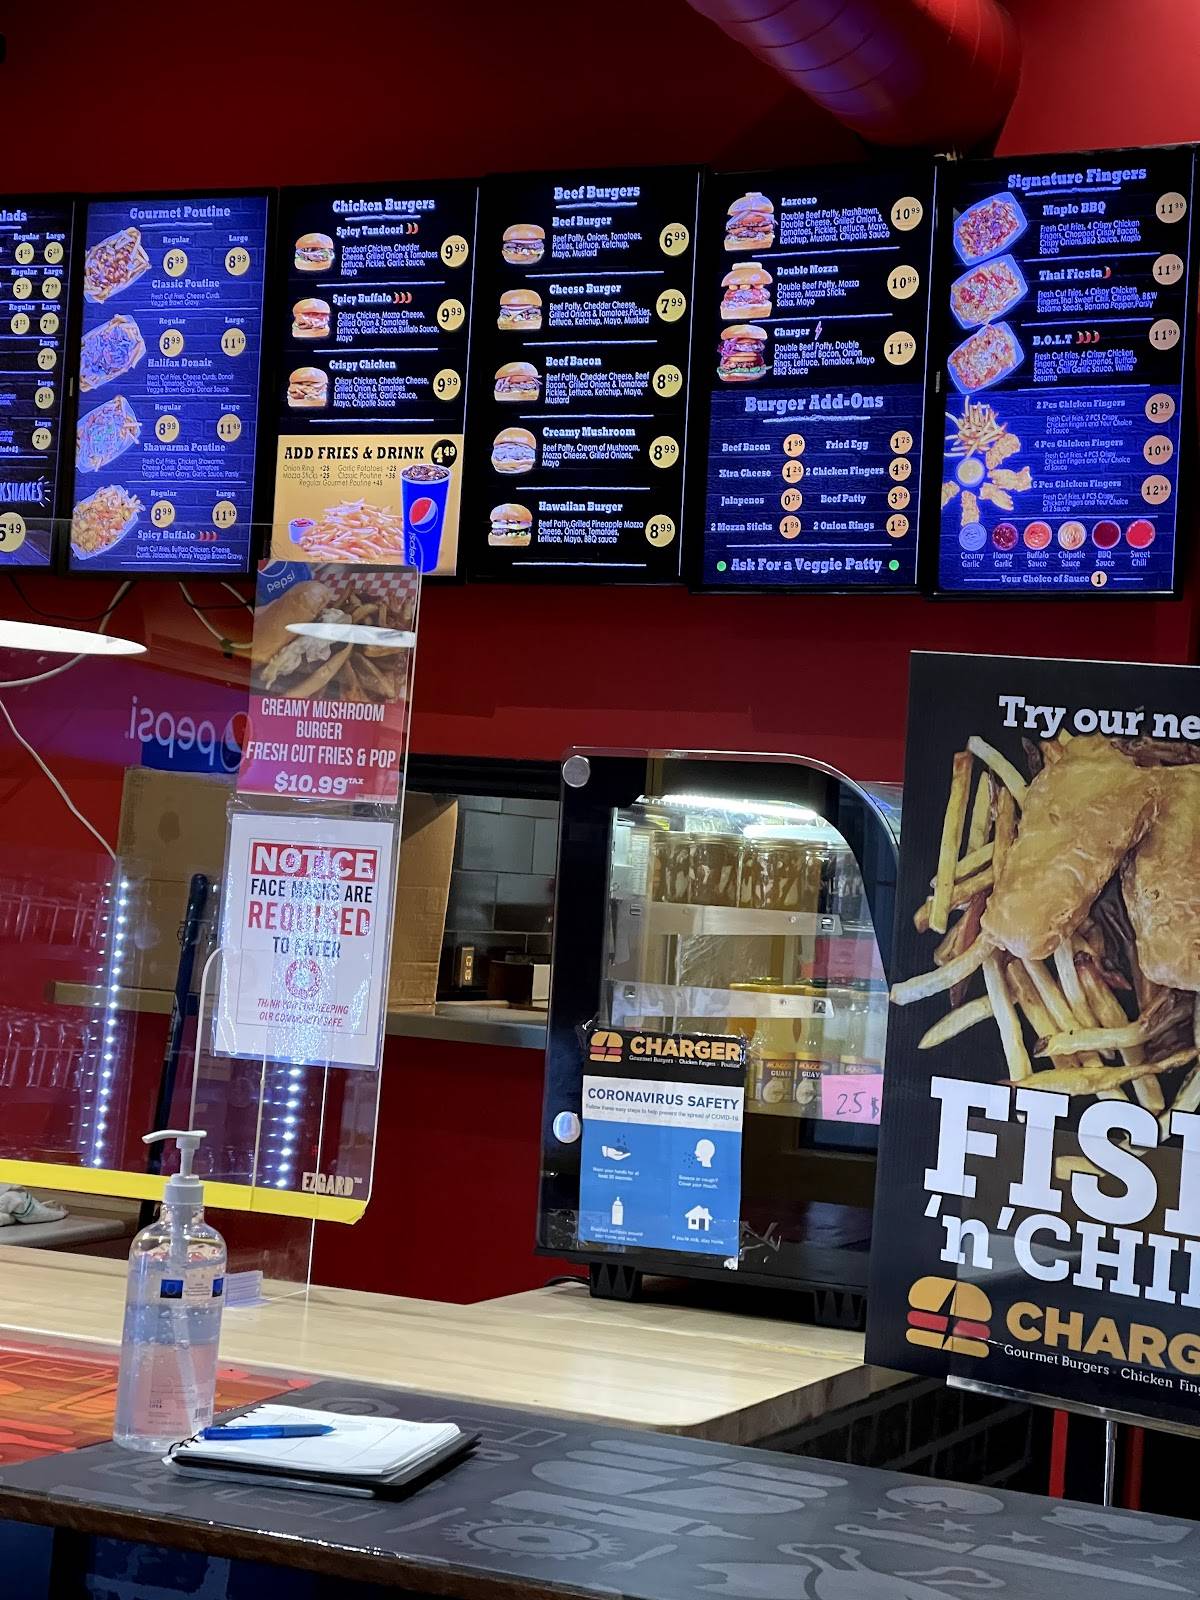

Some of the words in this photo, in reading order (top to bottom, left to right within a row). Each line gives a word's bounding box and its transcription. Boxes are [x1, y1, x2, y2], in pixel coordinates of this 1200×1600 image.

[1008, 172, 1082, 190] Signature
[1086, 168, 1146, 185] Fingers
[554, 187, 584, 200] Beef
[587, 186, 640, 200] Burgers
[333, 200, 382, 213] Chicken
[385, 199, 435, 212] Burgers
[1043, 205, 1079, 217] Maple
[1081, 202, 1105, 214] BBQ
[130, 207, 181, 219] Gourmet
[184, 206, 231, 218] Poutine
[552, 217, 575, 226] Beef
[577, 216, 612, 226] Burger
[336, 227, 360, 238] Spicy
[362, 225, 403, 235] Tandoori
[14, 233, 39, 241] Regular
[163, 236, 189, 244] Regular
[229, 235, 249, 243] Large
[552, 235, 567, 243] Beef
[777, 267, 808, 275] Double
[810, 265, 838, 274] Mozza
[1039, 270, 1065, 280] Thai
[1067, 268, 1103, 279] Fiesta
[152, 280, 182, 289] Classic
[184, 279, 220, 288] Poutine
[550, 284, 584, 294] Cheese
[586, 284, 621, 295] Burger
[333, 294, 356, 304] Spicy
[358, 293, 391, 303] Buffalo
[774, 328, 810, 337] Charger
[148, 358, 179, 367] Halifax
[182, 358, 212, 367] Donair
[329, 360, 358, 371] Crispy
[359, 360, 395, 369] Chicken
[546, 357, 568, 366] Beef
[570, 356, 601, 366] Bacon
[745, 397, 806, 415] Burger
[809, 393, 884, 410] Add-Ons
[1059, 400, 1092, 409] Chicken
[1094, 399, 1125, 408] Fingers
[543, 427, 580, 438] Creamy
[582, 427, 635, 436] Mushroom
[144, 443, 189, 452] Shawarma
[191, 443, 225, 452] Poutine
[722, 443, 742, 451] Beef
[743, 443, 770, 451] Bacon
[826, 441, 849, 449] Fried
[851, 441, 868, 450] Egg
[1091, 439, 1123, 447] Fingers
[285, 447, 313, 459] ADD
[318, 447, 358, 459] FRIES
[363, 447, 373, 459] &
[377, 447, 424, 459] DRINK
[719, 470, 739, 478] Xtra
[741, 469, 771, 477] Cheese
[812, 467, 848, 476] Chicken
[850, 466, 884, 476] Fingers
[1055, 480, 1088, 488] Chicken
[1090, 480, 1121, 488] Fingers
[821, 495, 841, 503] Beef
[842, 494, 866, 504] Patty
[539, 502, 585, 511] Hawaiian
[587, 502, 623, 512] Burger
[711, 523, 716, 531] 2
[718, 523, 745, 531] Mozza
[747, 523, 773, 531] Sticks
[849, 522, 874, 531] Rings
[138, 530, 161, 541] Spicy
[163, 530, 195, 540] Buffalo
[961, 553, 984, 561] Creamy
[1058, 551, 1085, 560] Chipotle
[1130, 550, 1150, 558] Sweet
[731, 558, 754, 570] Ask
[758, 558, 782, 570] For
[783, 562, 792, 570] a
[795, 558, 842, 573] Veggie
[845, 558, 882, 573] Patty
[1061, 559, 1080, 567] Sauce
[1096, 559, 1115, 567] Sauce
[1131, 558, 1147, 566] Chili
[267, 573, 295, 592] pepsi
[1001, 575, 1021, 583] Your
[1023, 574, 1051, 583] Choice
[1053, 574, 1063, 582] of
[261, 699, 308, 717] CREAMY
[312, 701, 385, 721] MUSHROOM
[999, 695, 1067, 738] Try
[1074, 707, 1144, 736] our
[296, 721, 342, 739] BURGER
[246, 742, 288, 761] FRESH
[291, 746, 313, 762] CUT
[318, 748, 353, 766] FRIES
[356, 749, 366, 766] &
[370, 750, 396, 767] POP
[275, 771, 347, 794] $10.99
[254, 846, 374, 879] NOTICE
[251, 879, 285, 896] FACE
[344, 886, 373, 902] ARE
[273, 937, 289, 954] TO
[630, 1037, 741, 1062] CHARGER
[629, 1055, 652, 1063] Gourmet
[588, 1088, 683, 1106] CORONAVIRUS
[688, 1096, 739, 1110] SAFETY
[1014, 1214, 1200, 1307] CHI
[1004, 1344, 1059, 1365] Gourmet
[1062, 1356, 1109, 1375] Burgers
[1121, 1368, 1173, 1388] Chicken
